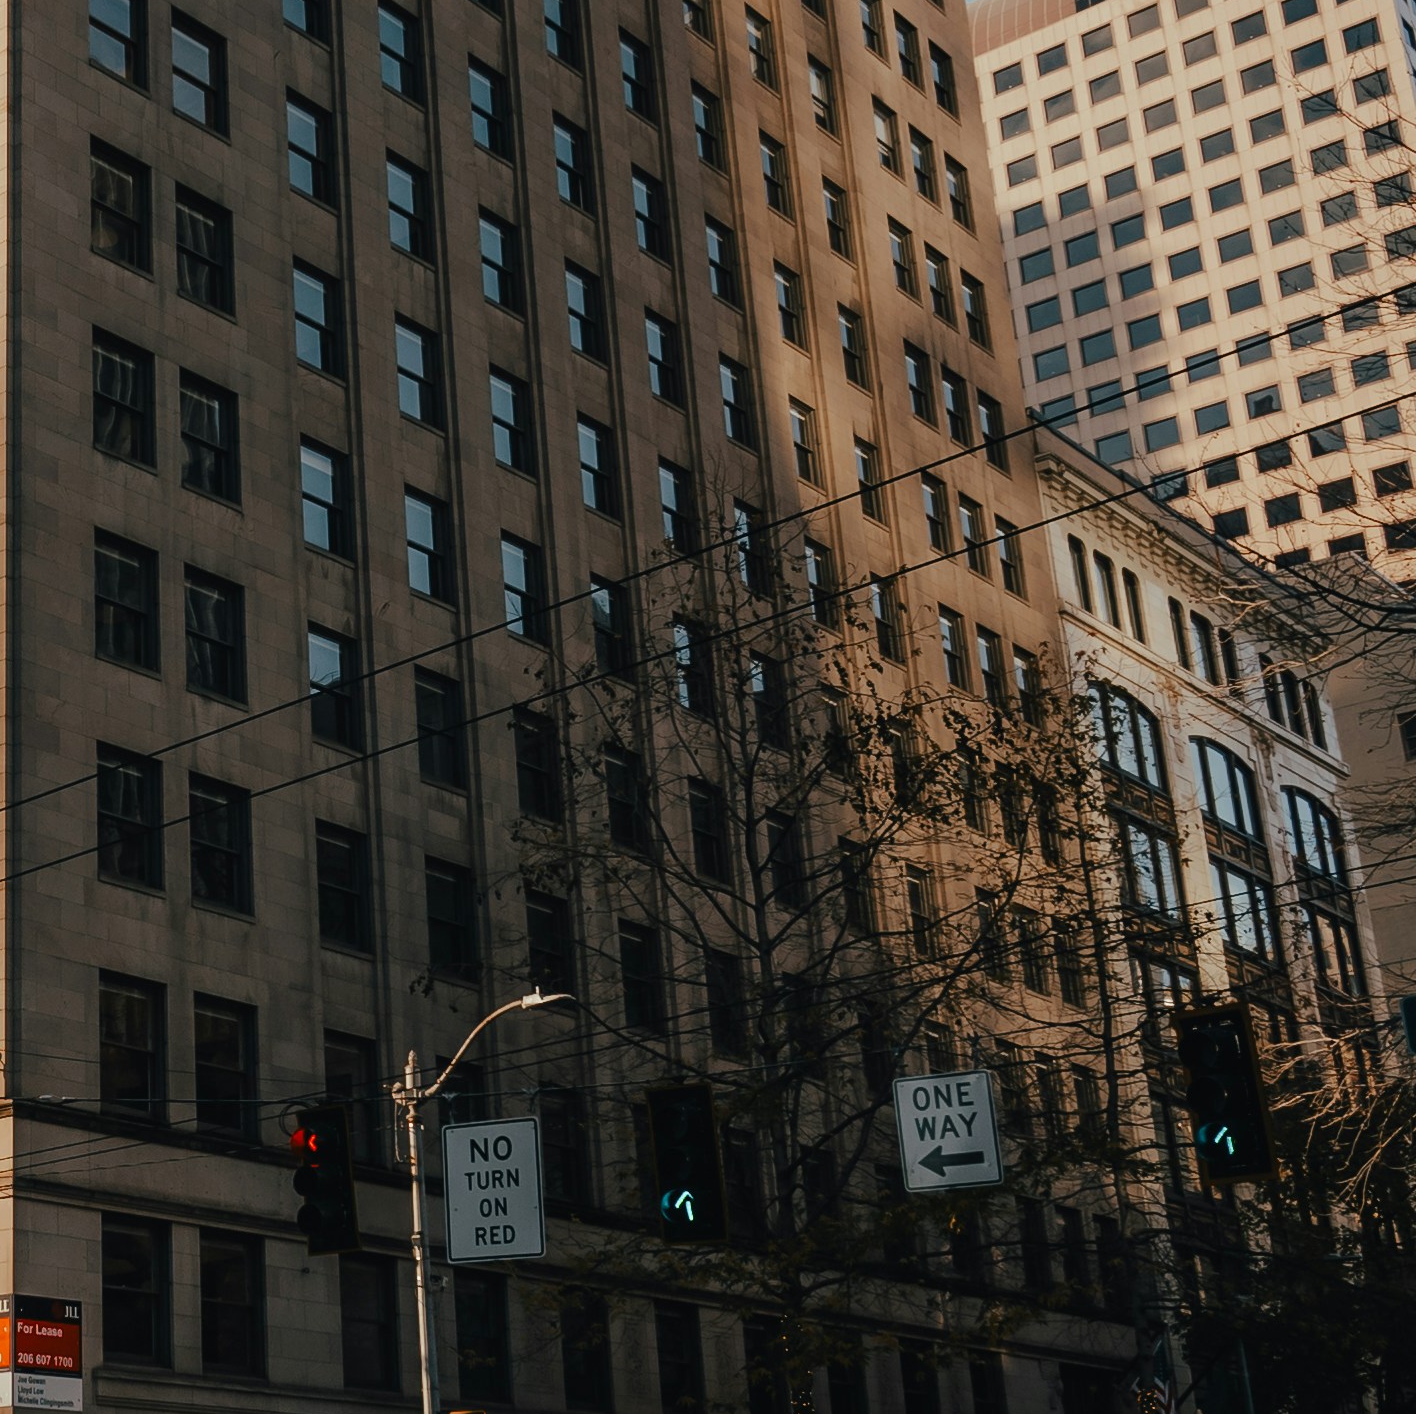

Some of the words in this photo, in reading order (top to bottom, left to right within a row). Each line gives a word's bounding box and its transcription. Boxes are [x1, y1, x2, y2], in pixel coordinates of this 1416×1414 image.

[912, 1082, 974, 1111] ONE
[914, 1112, 977, 1141] WAY
[470, 1136, 512, 1163] NO
[464, 1168, 519, 1191] TURN
[480, 1197, 507, 1217] ON
[475, 1225, 515, 1246] RED
[65, 1305, 79, 1319] JLL
[17, 1321, 33, 1334] For
[36, 1324, 63, 1337] Lease
[17, 1352, 33, 1364] 206
[35, 1354, 51, 1365] 607
[54, 1356, 73, 1367] 1700
[18, 1376, 27, 1384] Joe
[18, 1386, 32, 1395] Lloyd
